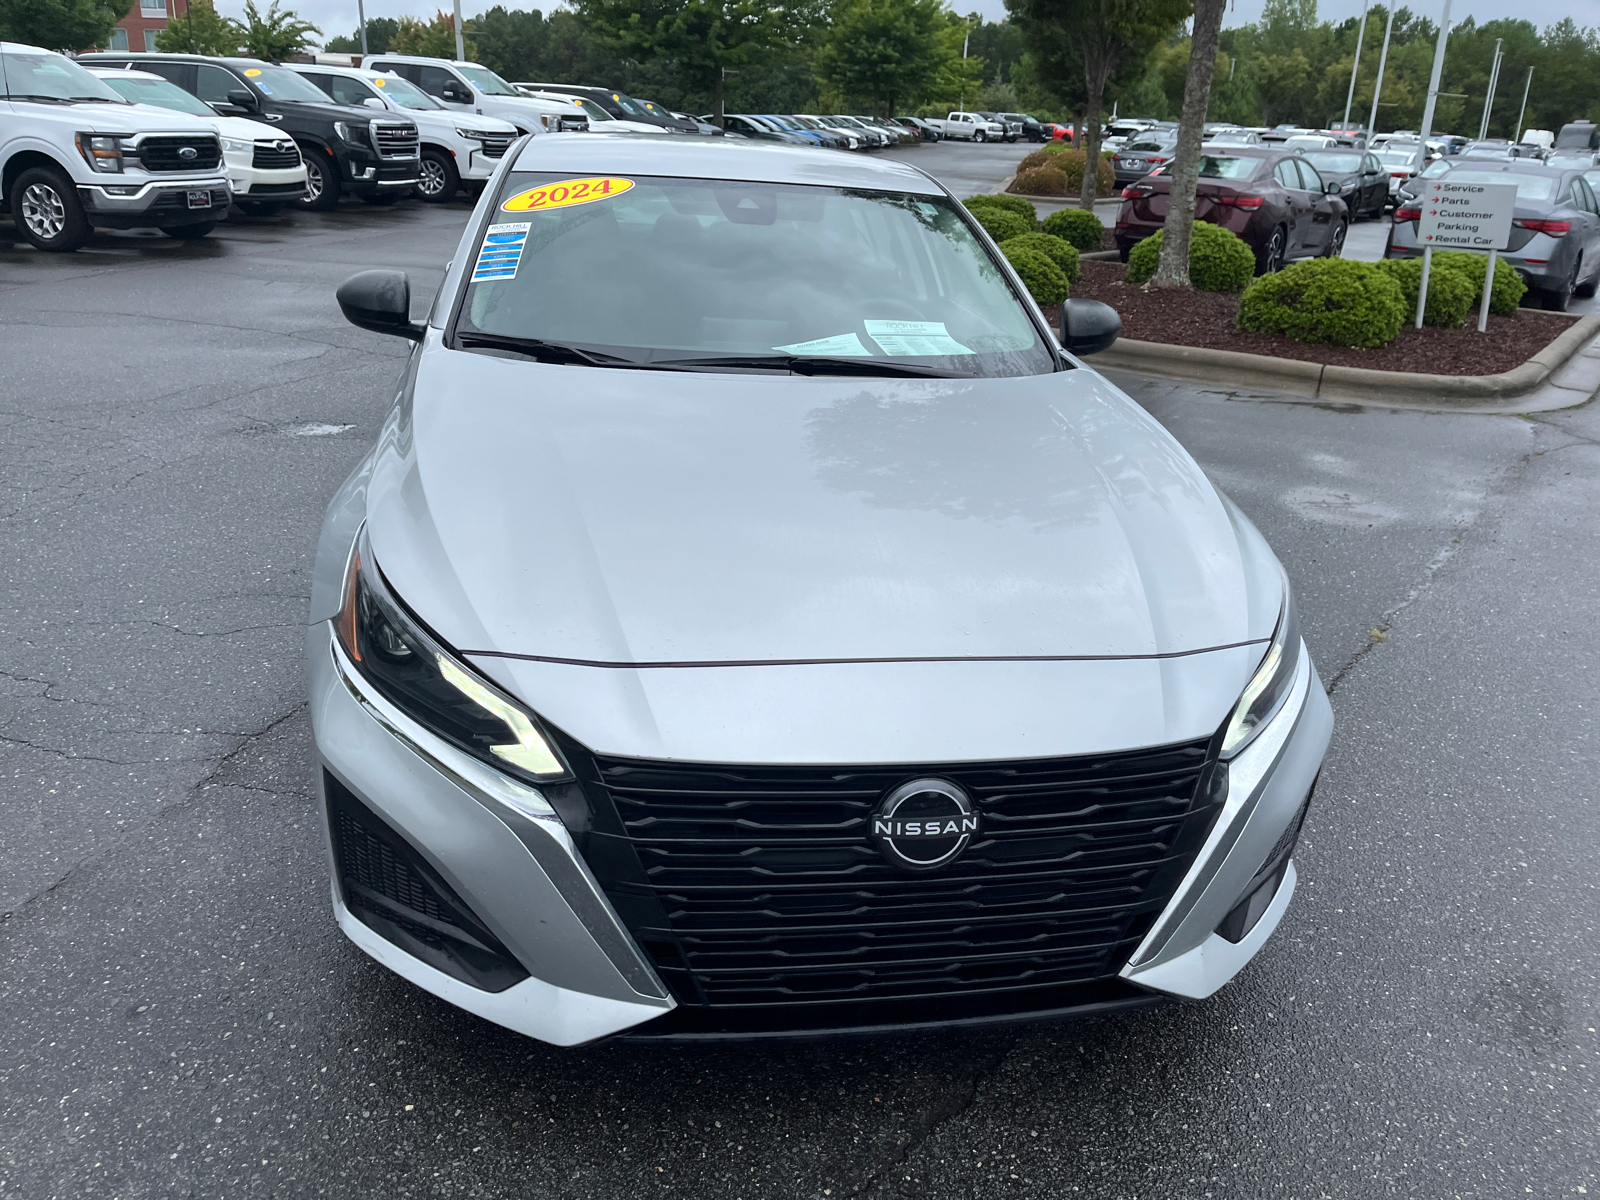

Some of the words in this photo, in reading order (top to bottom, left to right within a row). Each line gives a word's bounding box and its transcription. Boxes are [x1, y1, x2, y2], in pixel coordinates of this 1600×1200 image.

[1444, 184, 1484, 193] Service
[528, 180, 613, 208] 2024
[1441, 197, 1470, 205] Parts
[1439, 209, 1494, 219] Customer
[1437, 222, 1479, 233] Parking
[1435, 235, 1471, 244] Rental
[1473, 236, 1494, 245] Car
[875, 817, 977, 835] NISSAN
